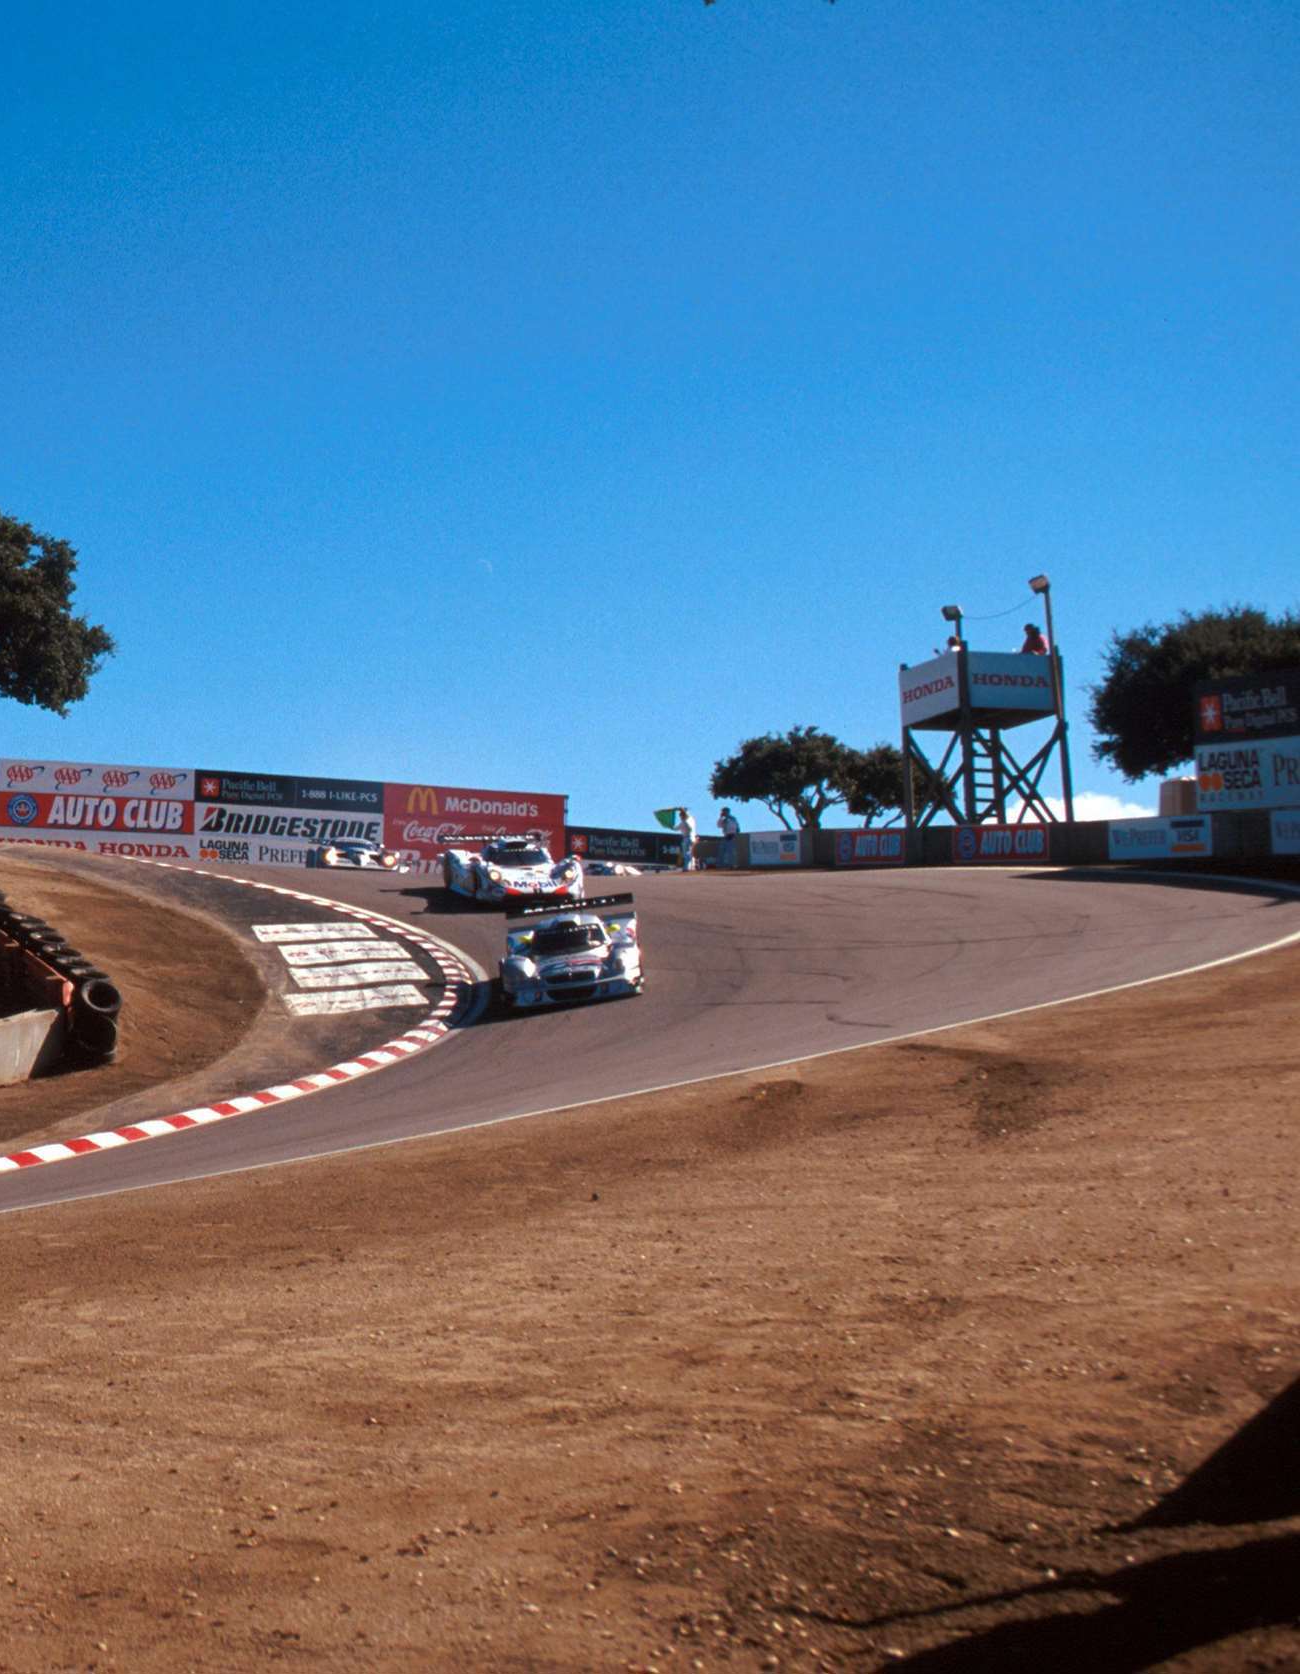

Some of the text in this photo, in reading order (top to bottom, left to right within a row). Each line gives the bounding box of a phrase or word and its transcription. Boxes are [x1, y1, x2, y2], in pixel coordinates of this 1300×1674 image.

[902, 675, 955, 704] HONDA
[972, 673, 1048, 688] HONDA
[1198, 749, 1260, 771] LAGUNA
[7, 765, 33, 783] AAA
[55, 767, 81, 785] AAA
[102, 770, 128, 788] AAA
[150, 772, 176, 790] AAA
[1223, 769, 1261, 791] SECA
[256, 780, 277, 793] Bell
[47, 796, 117, 828] AUTO
[123, 799, 185, 831] CLUB
[445, 797, 539, 818] McDonald's
[200, 807, 381, 841] BRIDGESTONE
[99, 842, 191, 858] HONDA
[200, 839, 249, 850] LAGUNA
[980, 829, 1045, 855] AUTO CLUB
[219, 850, 249, 861] SECA
